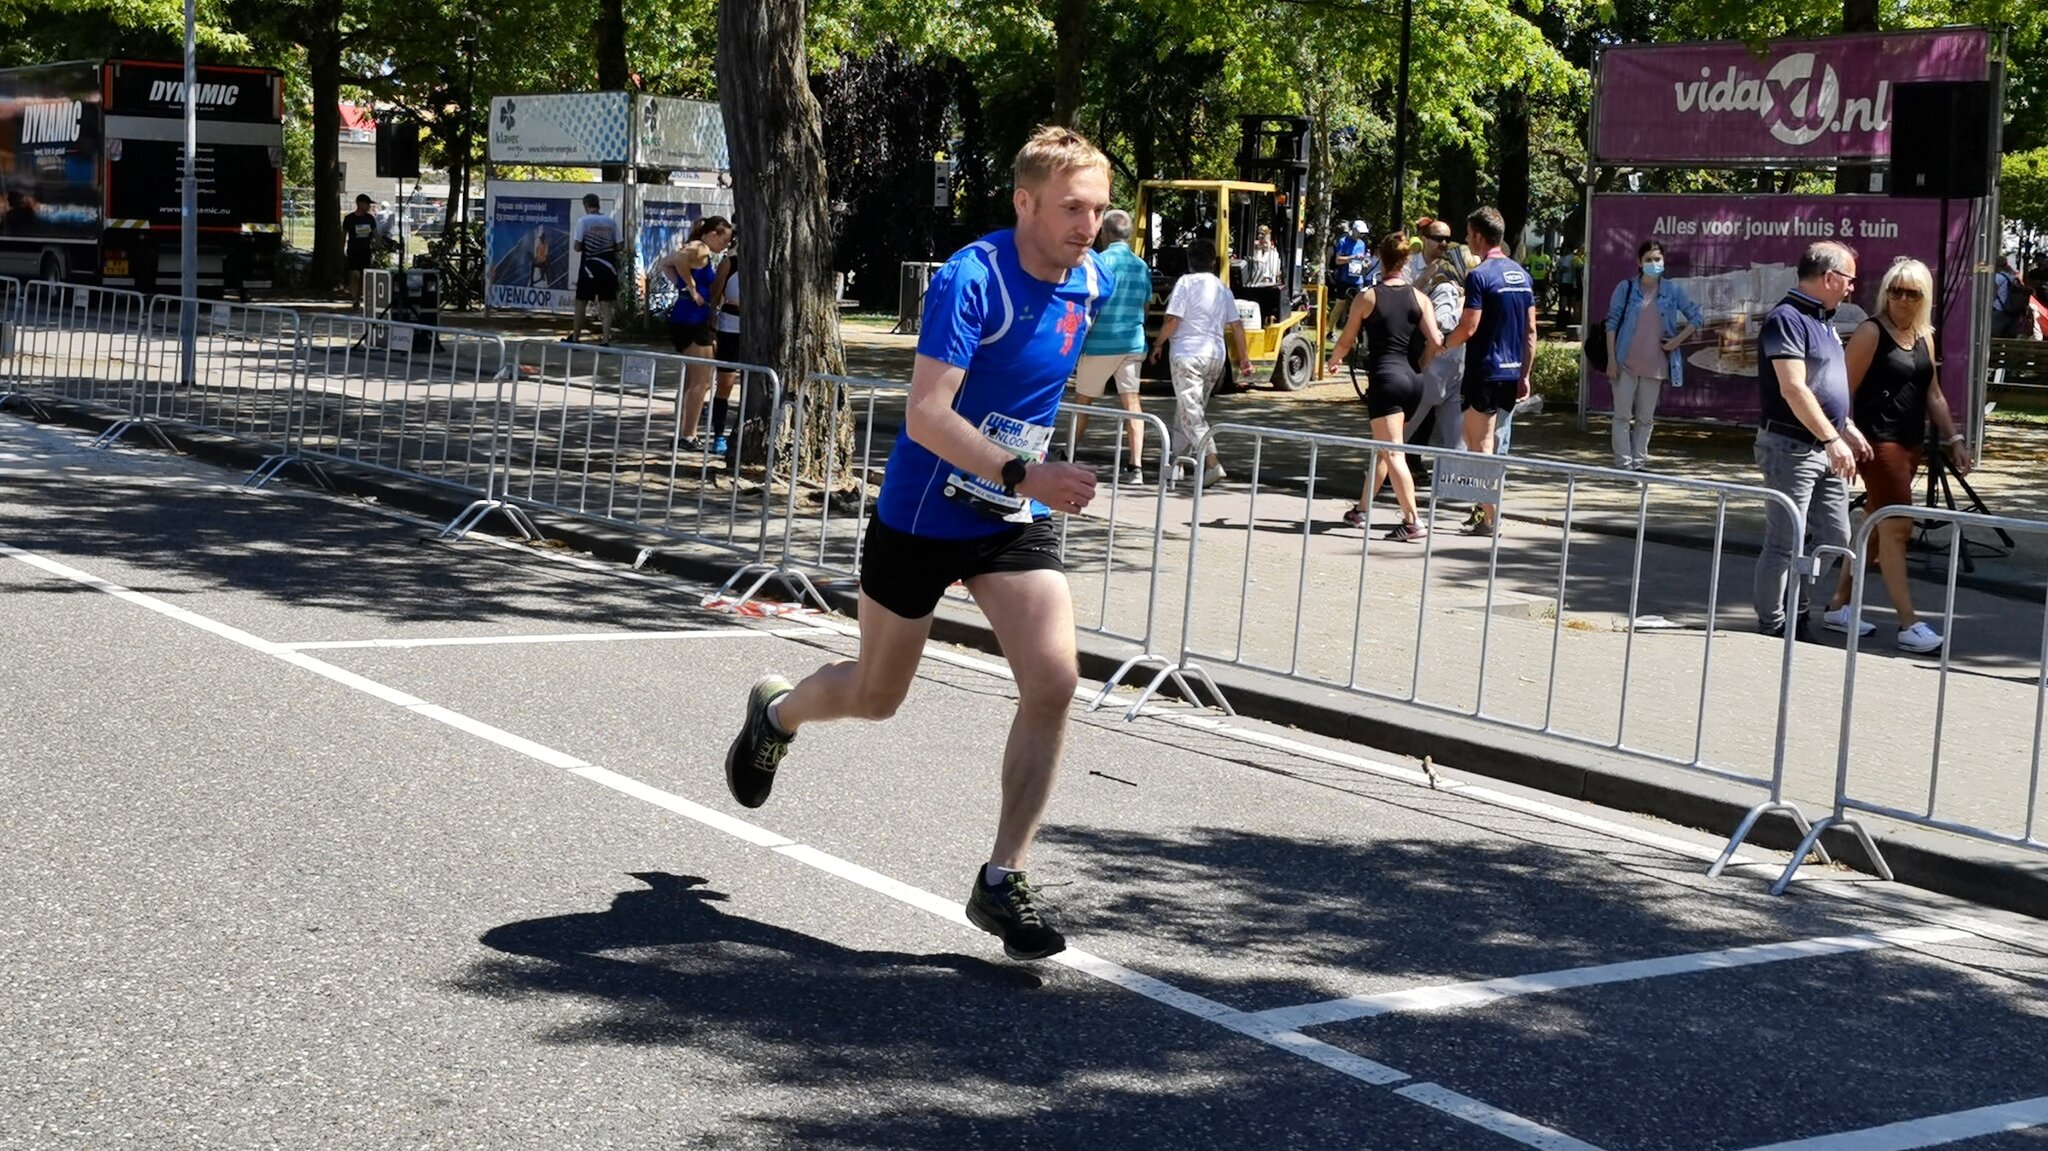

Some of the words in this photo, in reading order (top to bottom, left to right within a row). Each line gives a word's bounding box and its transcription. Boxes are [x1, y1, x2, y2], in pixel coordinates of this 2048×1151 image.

[21, 100, 82, 144] DYNAMIC
[159, 206, 231, 215] wwwamic.nu
[1652, 216, 1696, 235] Alles
[1702, 219, 1741, 235] voor
[1743, 217, 1790, 240] jouw
[1793, 216, 1834, 237] huis
[1839, 217, 1854, 238] &
[1859, 217, 1898, 238] tuin
[499, 287, 551, 307] VENLOOP
